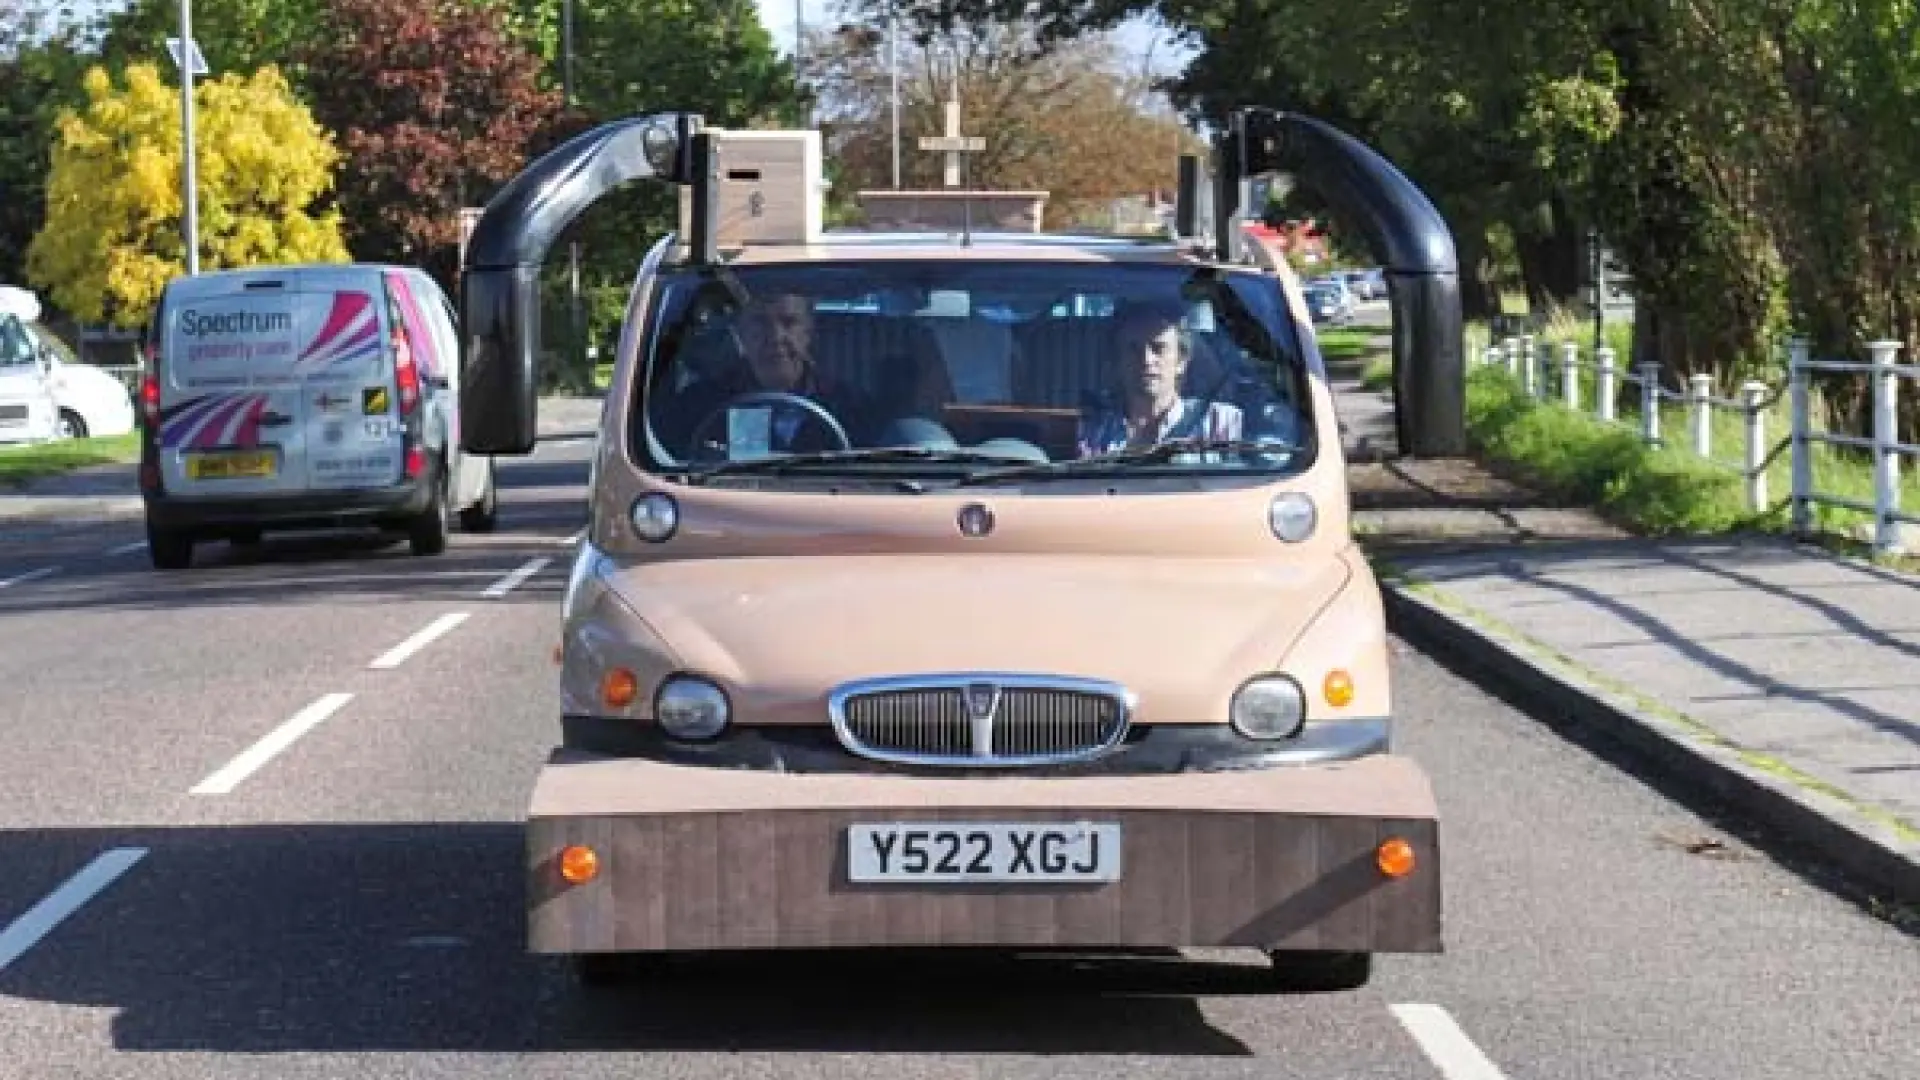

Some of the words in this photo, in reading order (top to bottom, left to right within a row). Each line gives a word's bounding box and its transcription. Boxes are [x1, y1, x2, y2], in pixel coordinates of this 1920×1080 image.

[182, 308, 292, 340] Spectrum
[870, 831, 993, 874] Y522
[1007, 831, 1099, 874] XGJ
